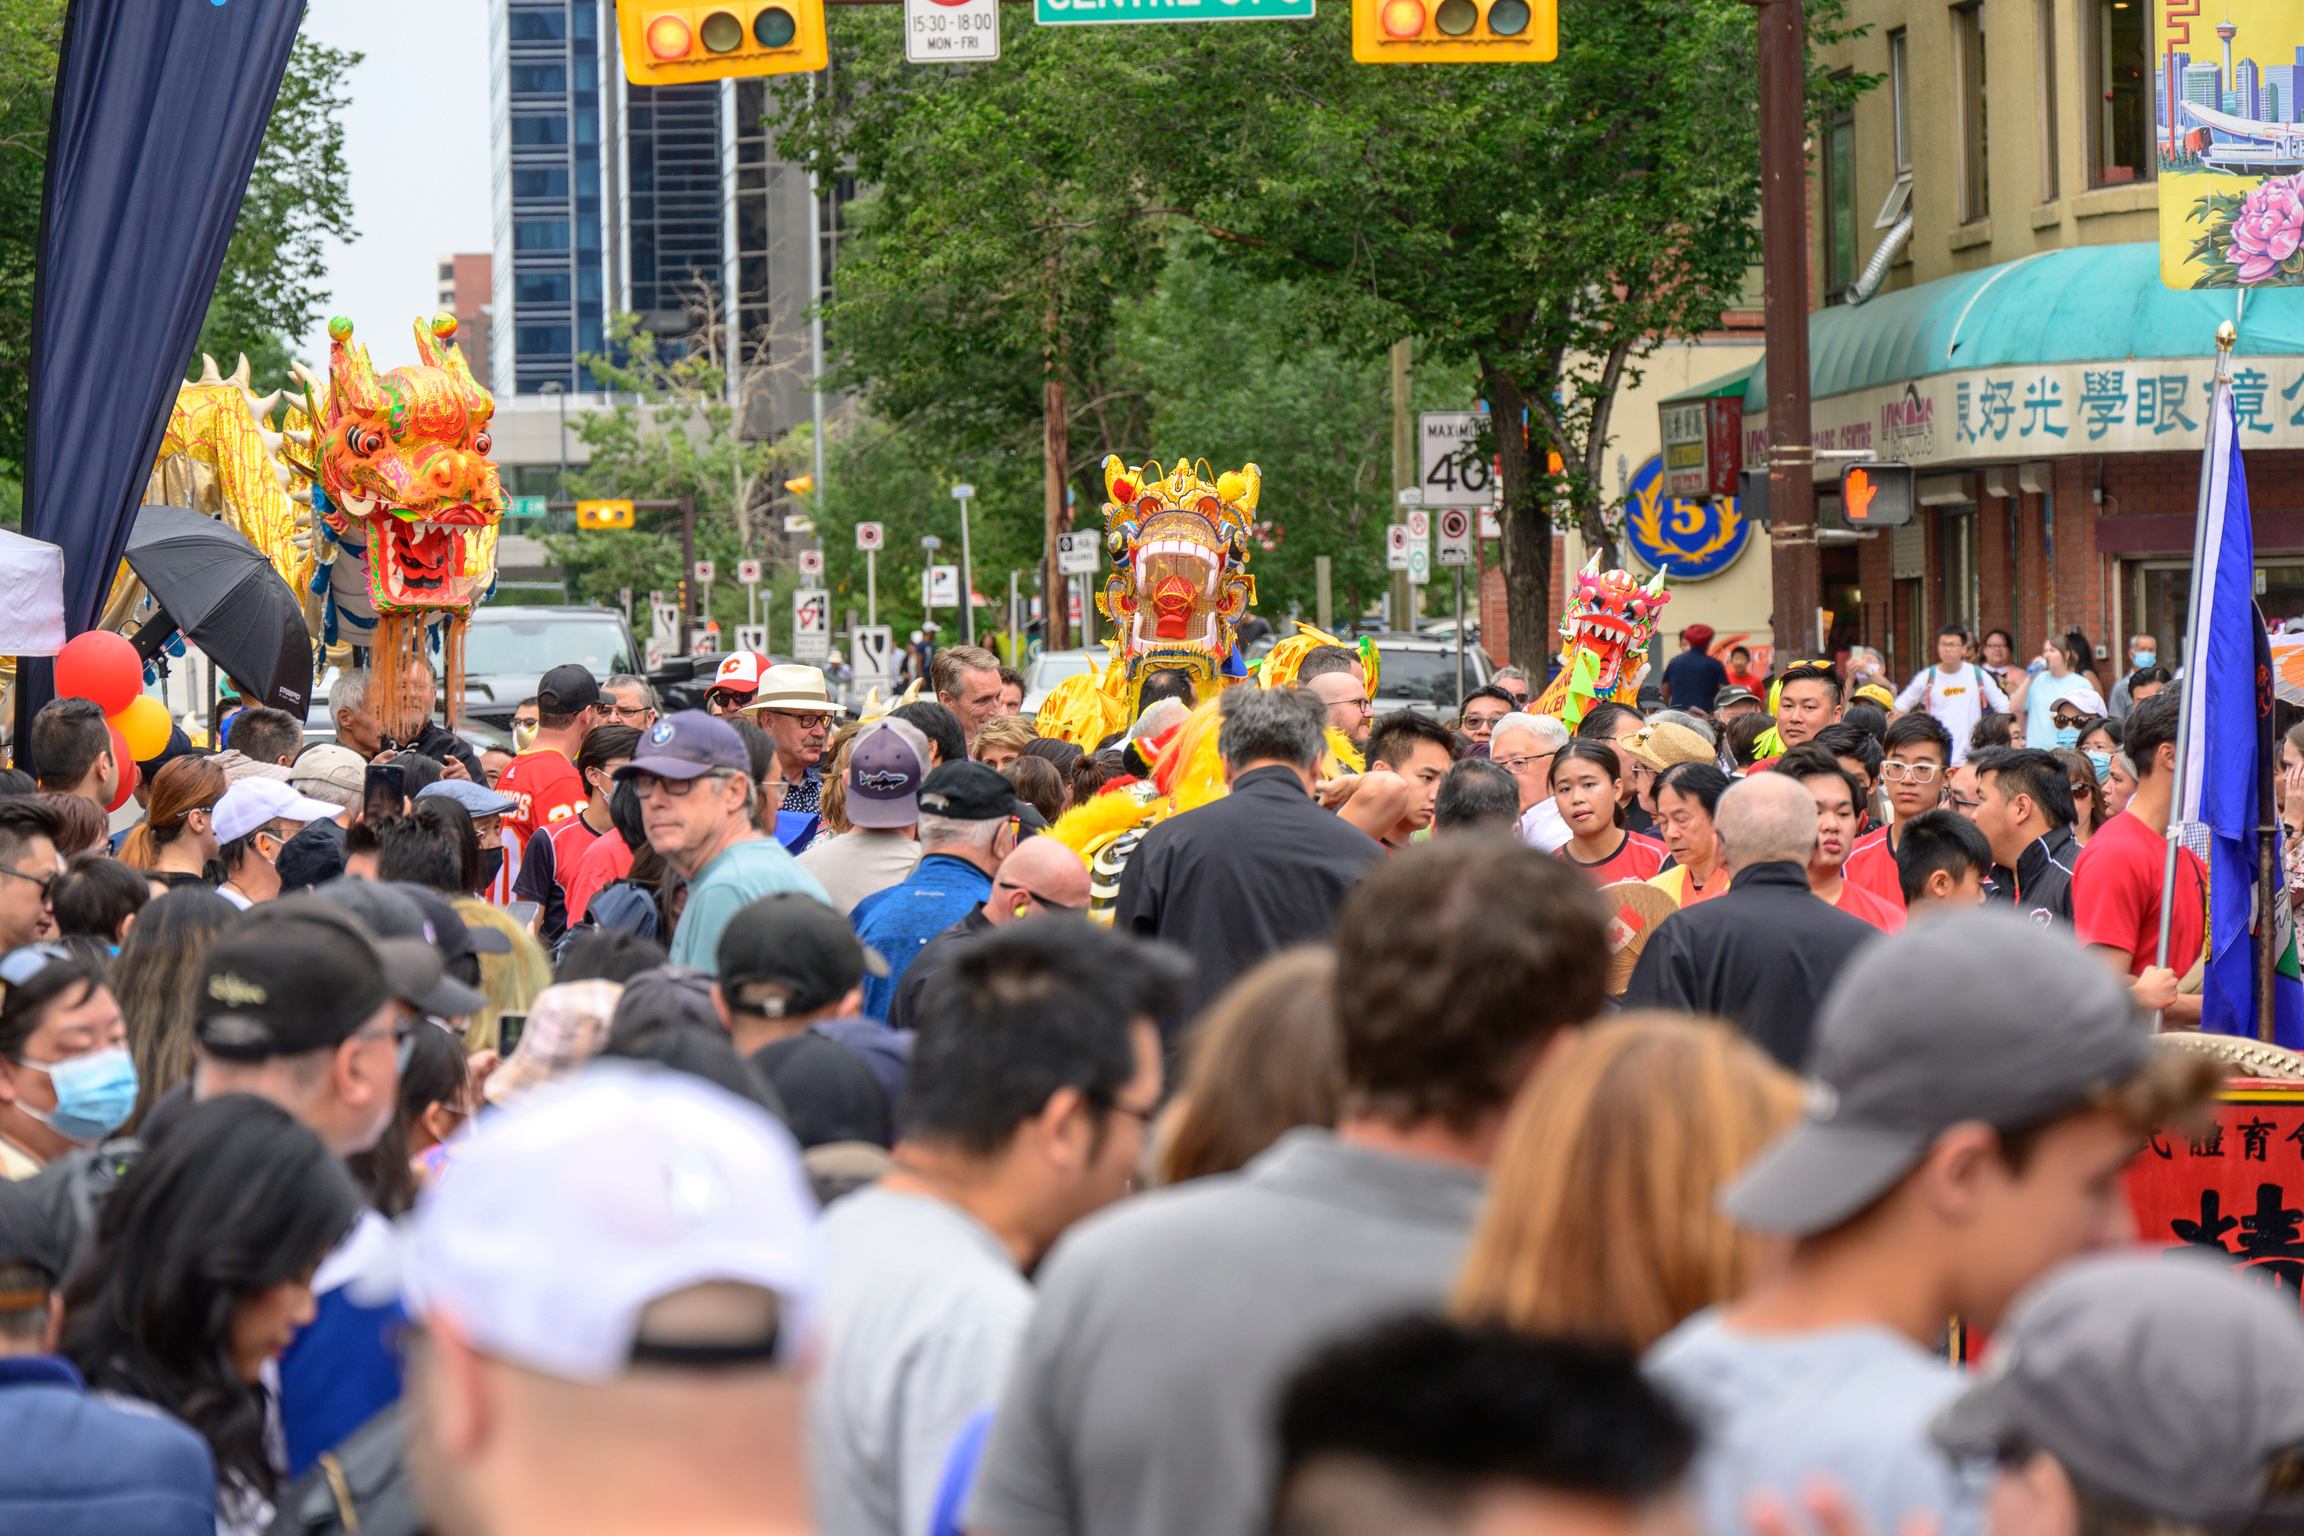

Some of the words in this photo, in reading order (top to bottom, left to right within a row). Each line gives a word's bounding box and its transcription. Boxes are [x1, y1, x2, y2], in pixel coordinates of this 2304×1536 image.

[912, 14, 946, 32] 15:30
[957, 13, 992, 31] 18:00
[1427, 422, 1490, 438] MAXIMU
[1427, 453, 1489, 492] 40
[1671, 496, 1707, 534] 5
